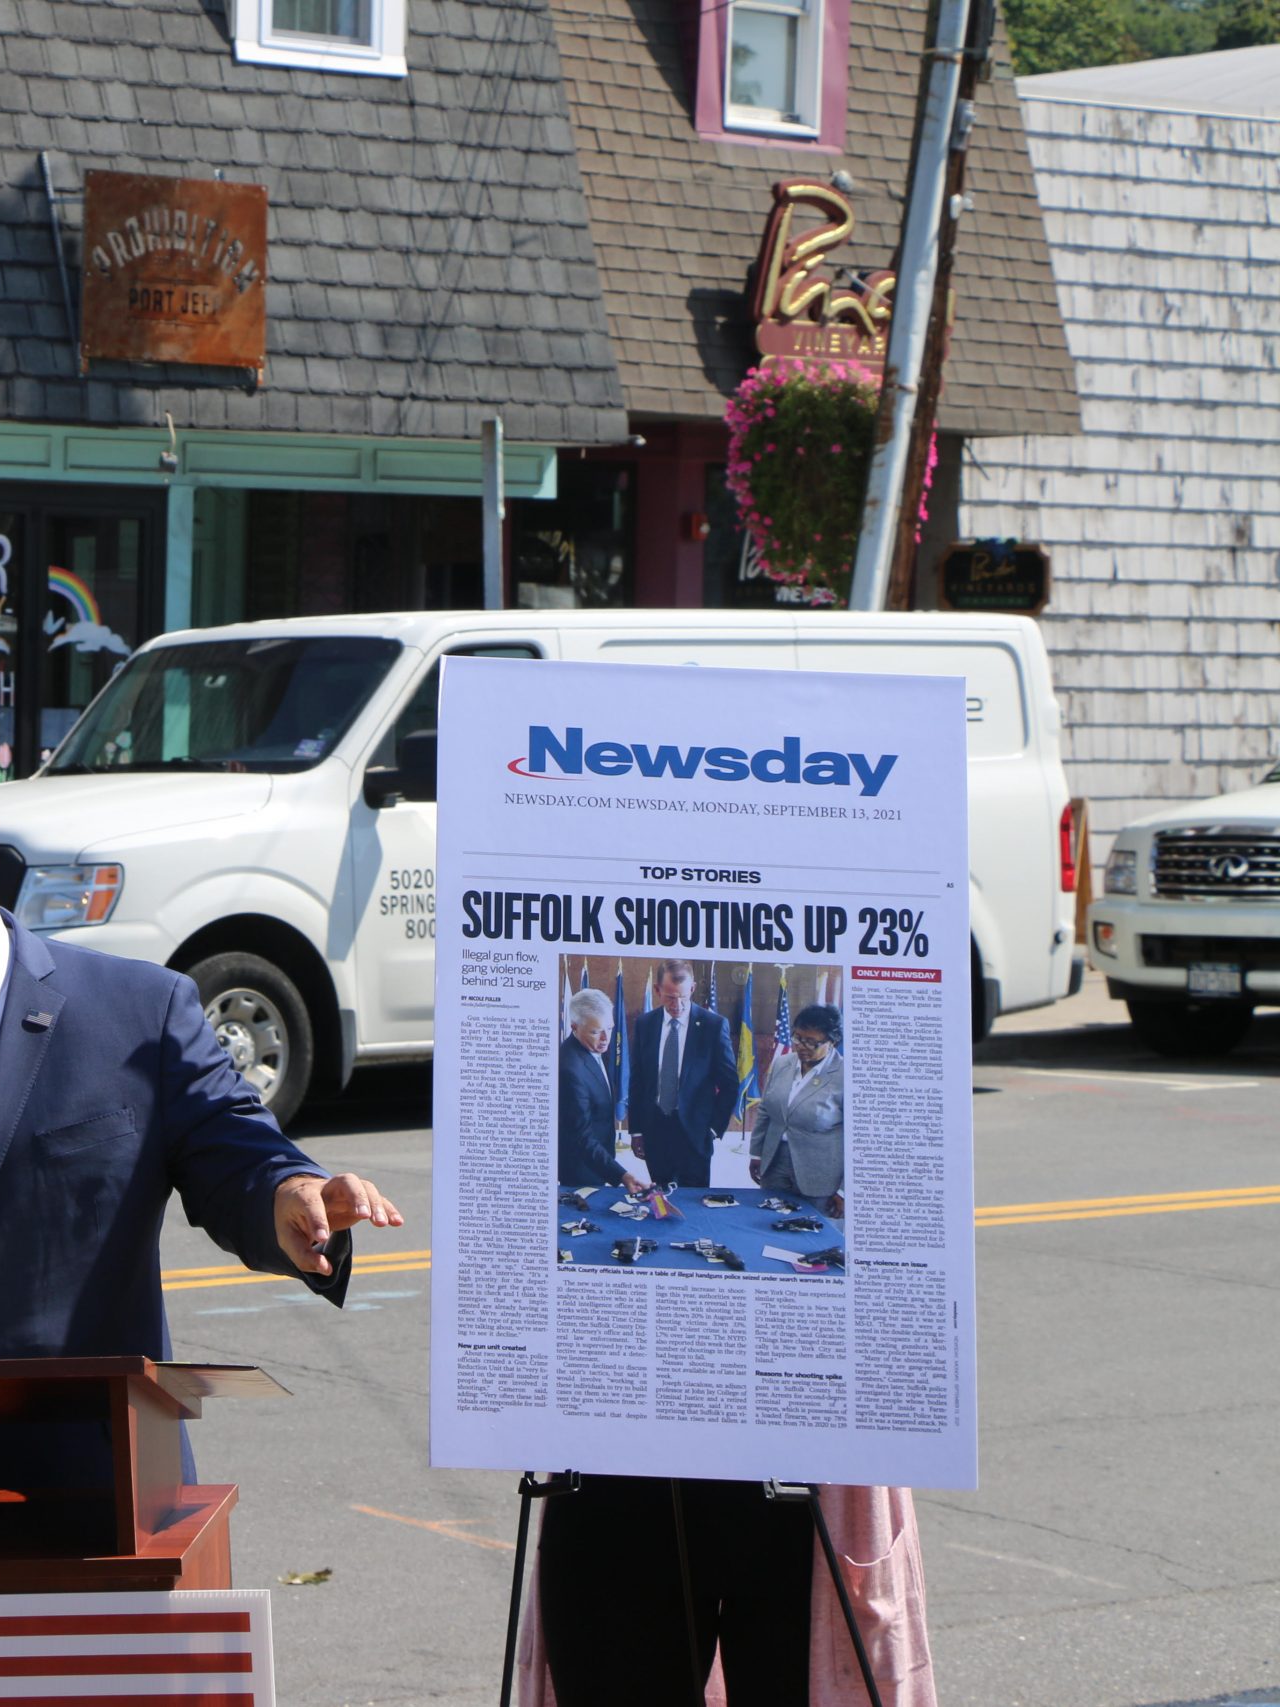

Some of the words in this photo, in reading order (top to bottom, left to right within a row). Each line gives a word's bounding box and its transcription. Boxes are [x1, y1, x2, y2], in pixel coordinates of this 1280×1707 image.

[129, 287, 174, 315] PORT
[794, 331, 886, 355] VINEYAR
[527, 725, 900, 797] Newsday
[504, 793, 613, 808] NEWSDAY.COM
[615, 797, 688, 813] NEWSDAY,
[692, 800, 761, 816] MONDAY,
[763, 803, 847, 819] SEPTEMBER
[851, 807, 870, 823] 13,
[873, 808, 903, 822] 2021
[390, 869, 435, 890] 5020
[640, 865, 678, 881] TOP
[681, 867, 762, 884] STORIES
[380, 894, 435, 916] SPRING
[462, 889, 604, 943] SUFFOLK
[614, 897, 794, 952] SHOOTINGS
[804, 905, 847, 954] UP
[858, 908, 929, 958] 23%
[462, 948, 492, 964] Illegal
[494, 953, 515, 965] gun
[516, 951, 540, 965] flow,
[461, 965, 487, 977] gang
[488, 963, 532, 976] violence
[857, 969, 880, 977] ONLY
[892, 971, 936, 979] NEWSDAY
[461, 975, 498, 988] behind
[516, 980, 546, 992] surge
